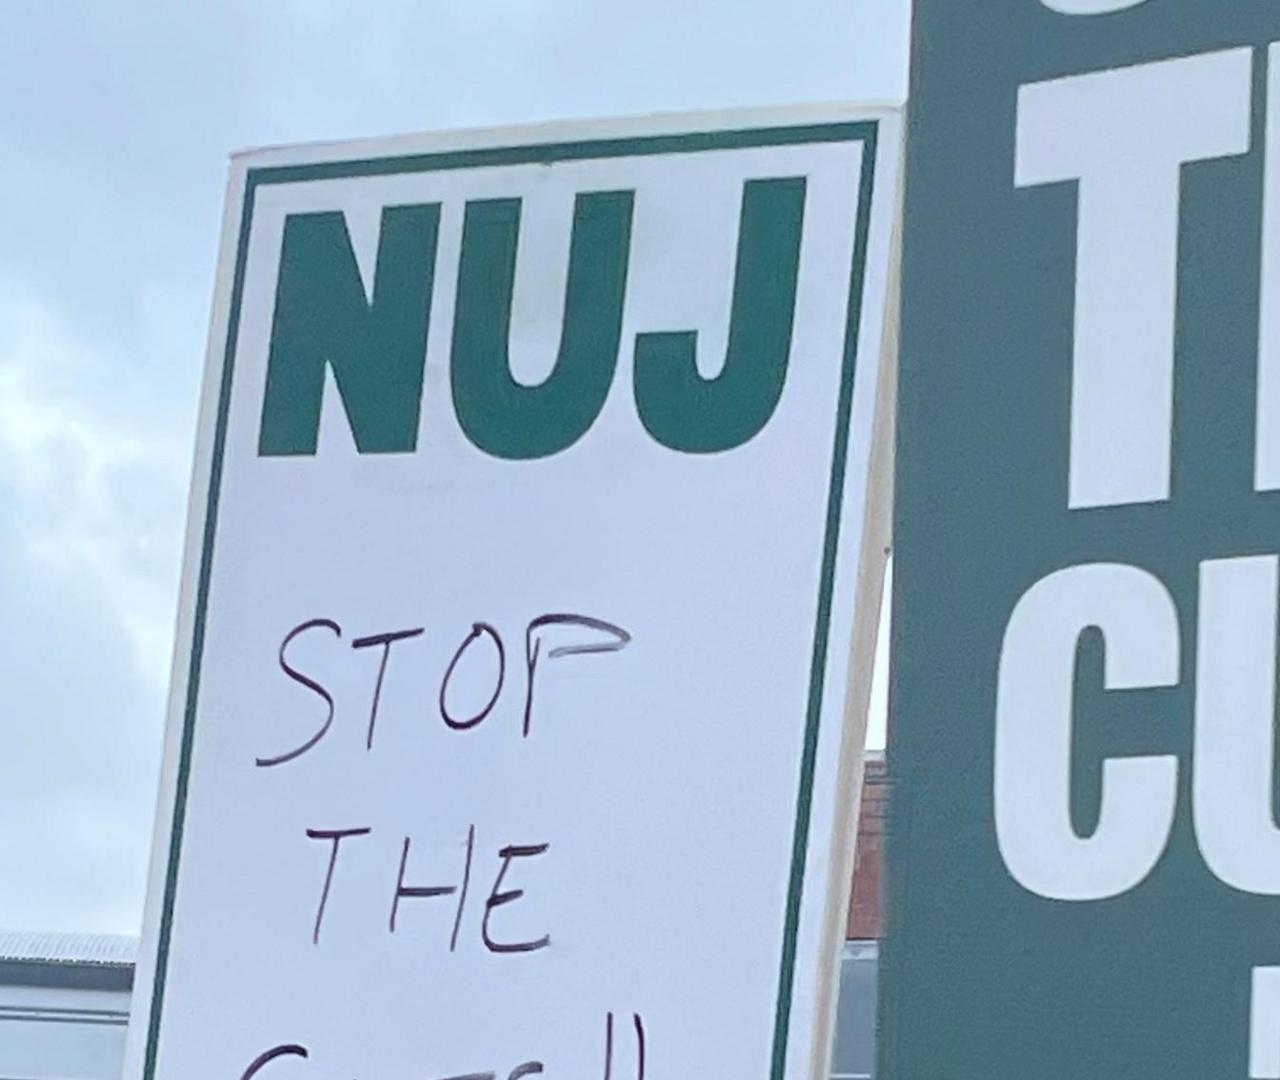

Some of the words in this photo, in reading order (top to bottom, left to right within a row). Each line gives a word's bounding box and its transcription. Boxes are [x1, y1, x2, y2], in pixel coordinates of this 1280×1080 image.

[257, 174, 808, 460] NUJ
[255, 612, 632, 767] STOP
[306, 824, 550, 953] THE
